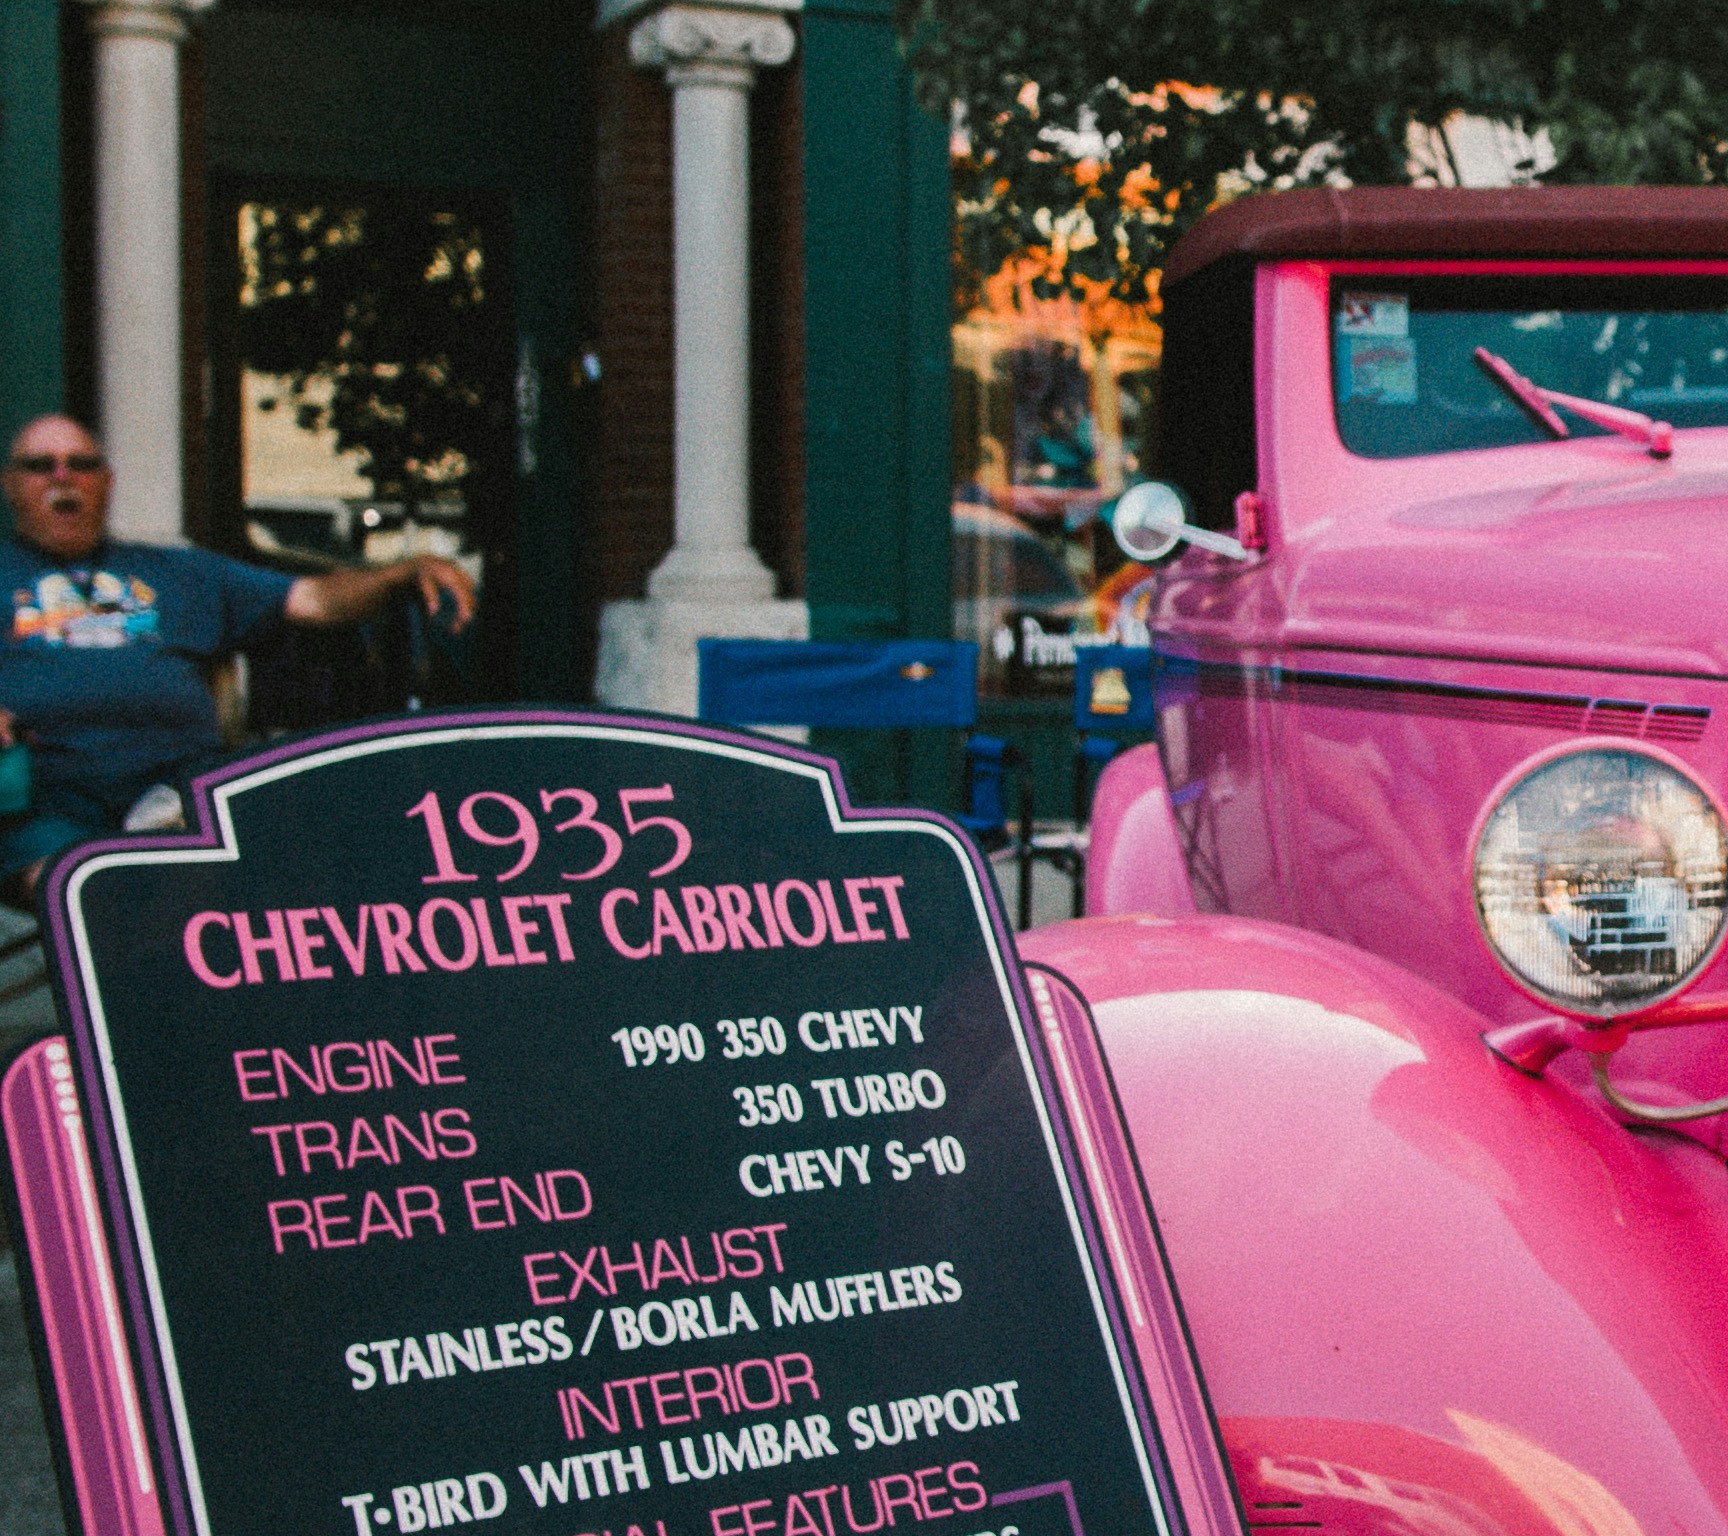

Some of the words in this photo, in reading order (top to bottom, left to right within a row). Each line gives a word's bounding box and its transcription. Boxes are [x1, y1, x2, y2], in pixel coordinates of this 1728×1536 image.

[408, 785, 691, 882] 1935
[184, 894, 574, 987] CHEVROLET
[601, 877, 908, 958] CABRIOLET
[234, 1034, 465, 1101] ENGINE
[612, 1023, 705, 1066] 1990
[717, 1017, 786, 1058] 350
[798, 1006, 923, 1052] CHEVY
[733, 1083, 803, 1126] 350
[811, 1069, 946, 1117] TURBO
[252, 1108, 477, 1175] TRANS
[739, 1145, 870, 1197] CHEVY
[885, 1136, 965, 1180] S-10
[268, 1186, 445, 1252] REAR
[464, 1170, 592, 1230] END
[524, 1223, 786, 1305] EXHAUST
[346, 1317, 572, 1390] STAINLESS
[610, 1292, 758, 1350] BORLA
[770, 1262, 961, 1326] MUFFLERS
[558, 1353, 819, 1439] INTERIOR
[519, 1447, 649, 1507] WITH
[660, 1415, 838, 1483] LUMBAR
[848, 1381, 1019, 1450] SUPPORT
